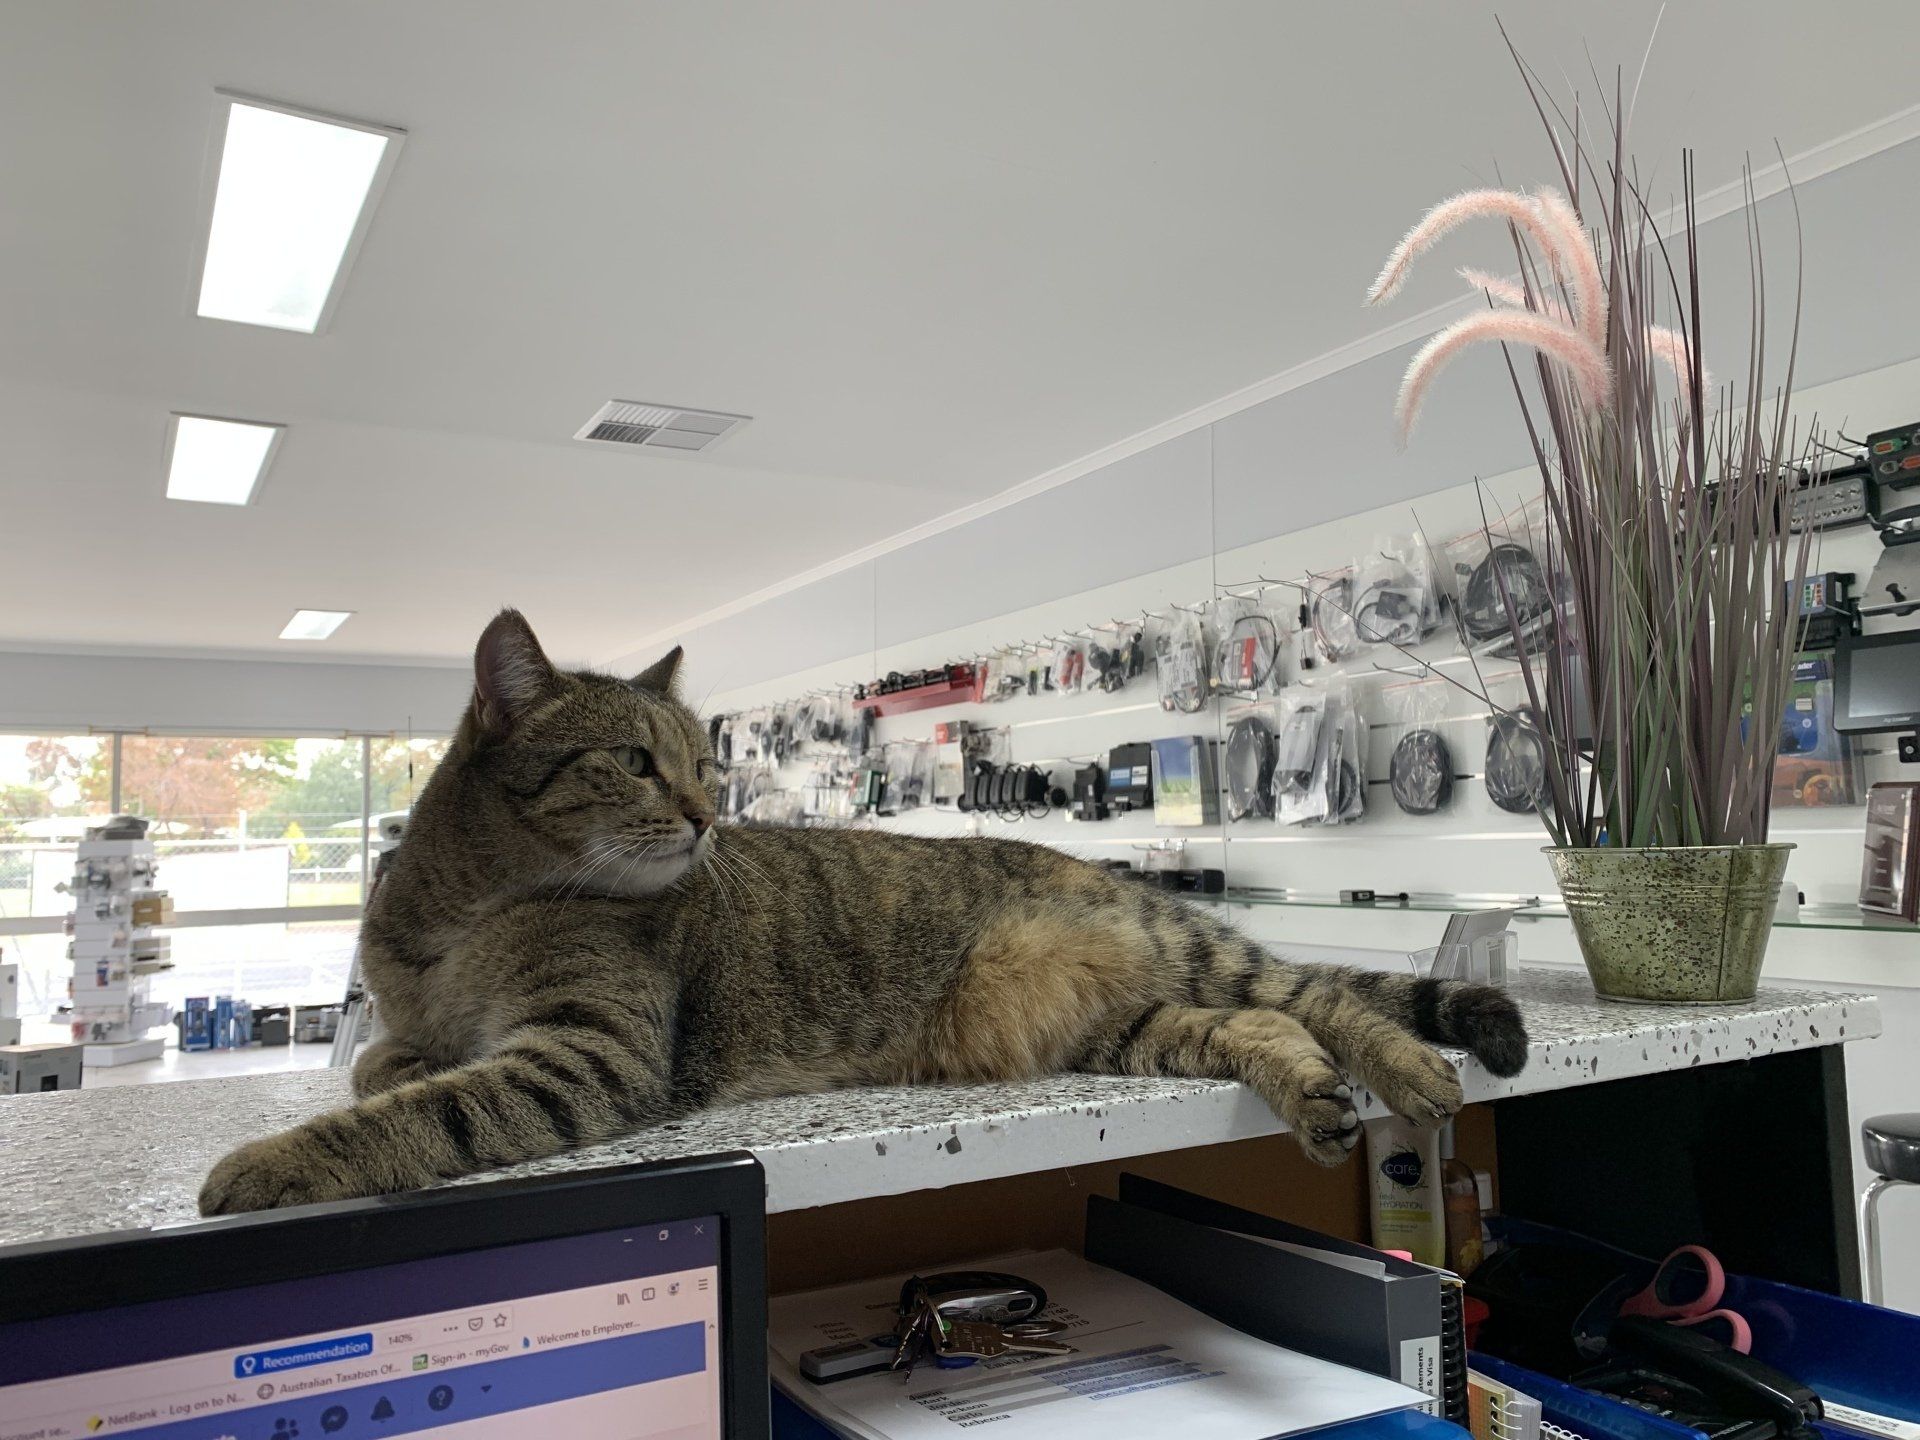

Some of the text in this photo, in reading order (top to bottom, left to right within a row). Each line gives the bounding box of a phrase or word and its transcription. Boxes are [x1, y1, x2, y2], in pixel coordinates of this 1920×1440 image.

[389, 1334, 413, 1344] 140%
[537, 1330, 579, 1345] Welcome
[581, 1328, 591, 1336] to
[263, 1342, 369, 1369] Recommendation
[431, 1351, 466, 1366] Sign-in
[475, 1344, 510, 1357] myGov
[280, 1378, 333, 1394] Australian
[336, 1369, 378, 1383] Taxation
[916, 1396, 948, 1406] Mark
[107, 1409, 158, 1426] NetBank
[169, 1404, 191, 1416] Log
[194, 1400, 209, 1410] on
[212, 1398, 224, 1408] to
[940, 1403, 989, 1416] Jackson
[947, 1411, 983, 1422] Carlo
[959, 1413, 1012, 1428] Rebecca
